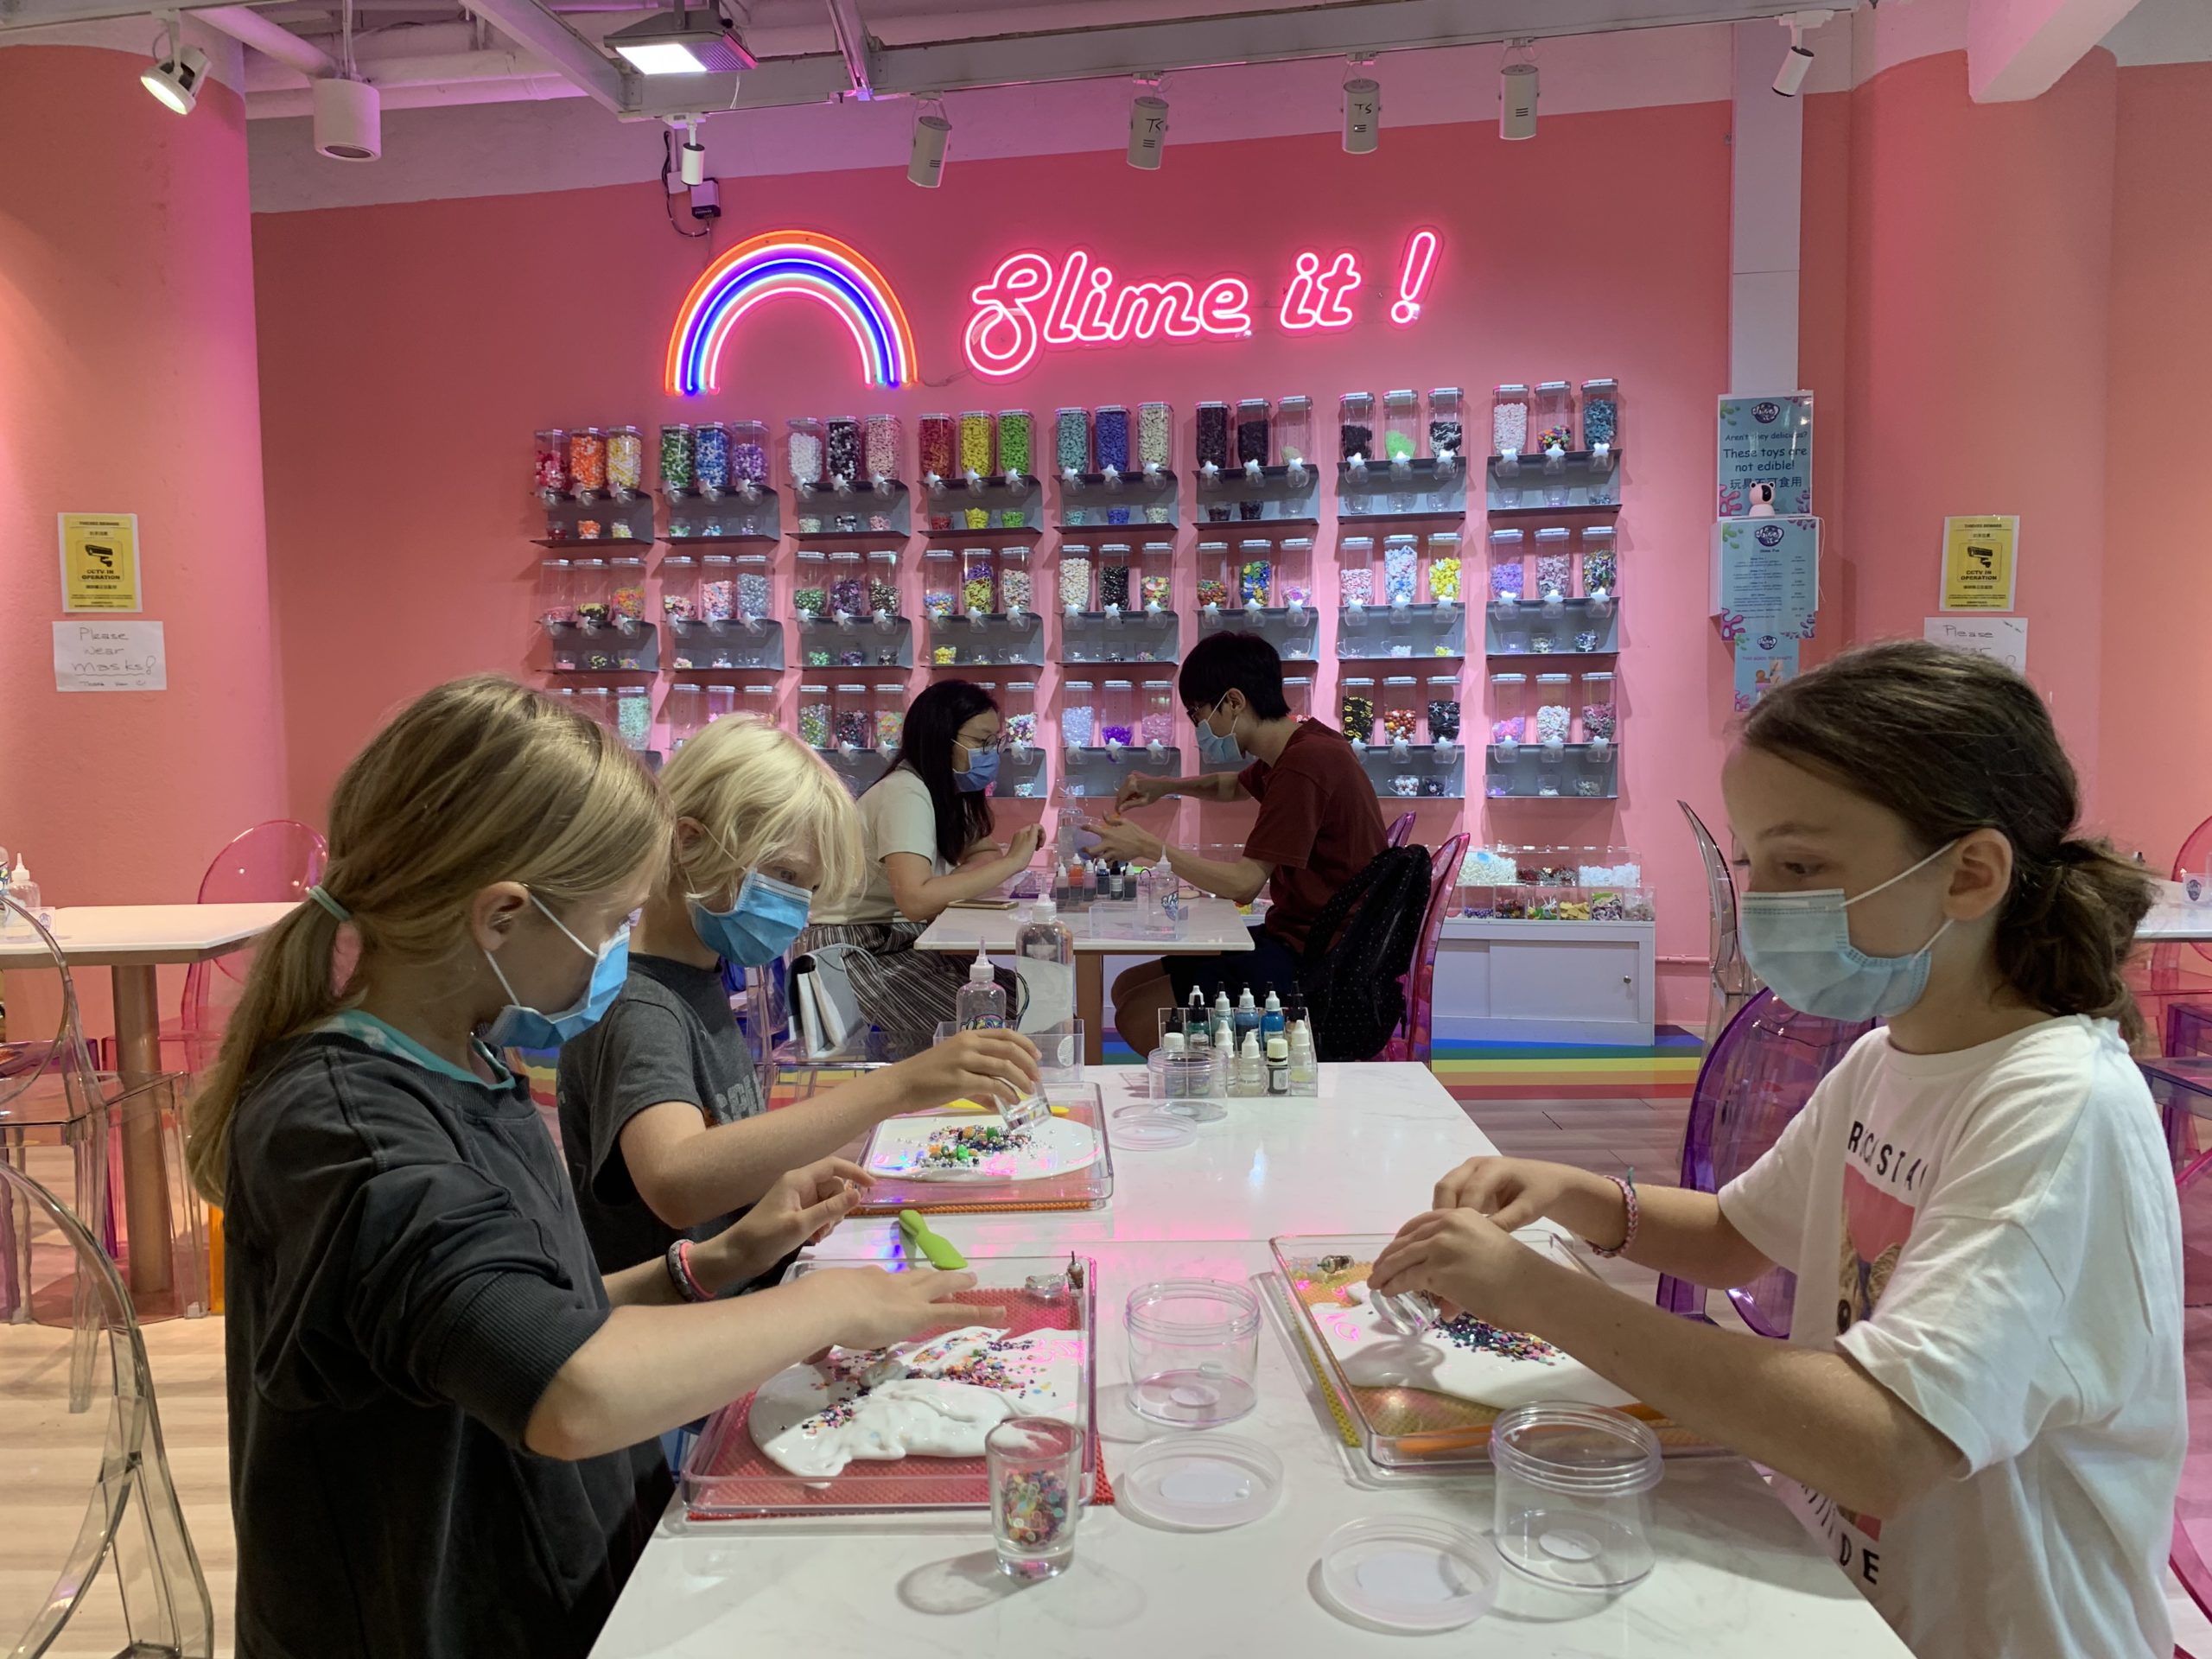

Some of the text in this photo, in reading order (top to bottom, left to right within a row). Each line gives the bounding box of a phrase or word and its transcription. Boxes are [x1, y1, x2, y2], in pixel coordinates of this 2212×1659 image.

[964, 250, 1251, 377] Slime
[1279, 251, 1362, 329] it
[1722, 448, 1758, 459] These
[1761, 448, 1785, 459] toys
[1735, 460, 1795, 473] not edible!
[79, 626, 129, 640] Please
[1942, 624, 1994, 638] Please
